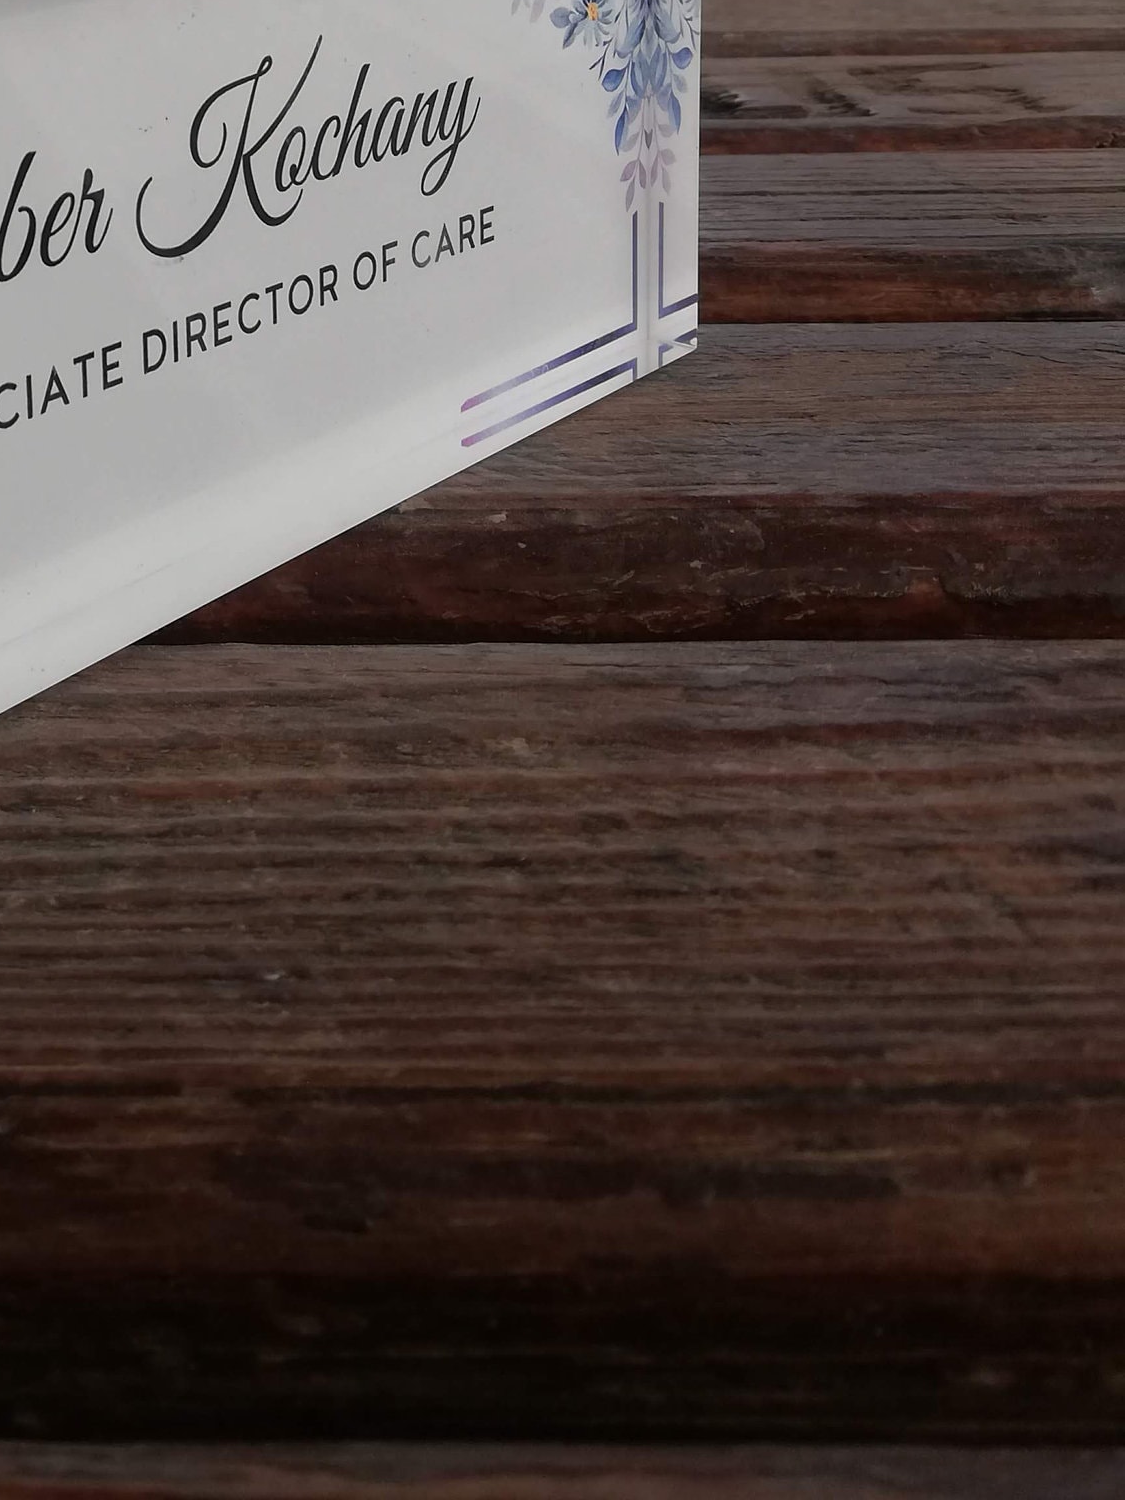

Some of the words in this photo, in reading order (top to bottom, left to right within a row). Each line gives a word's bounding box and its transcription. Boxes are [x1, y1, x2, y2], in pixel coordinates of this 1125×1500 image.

[134, 33, 482, 263] Kochany
[141, 263, 340, 376] DIRECTOR
[351, 238, 400, 292] OF
[410, 204, 496, 270] CARE
